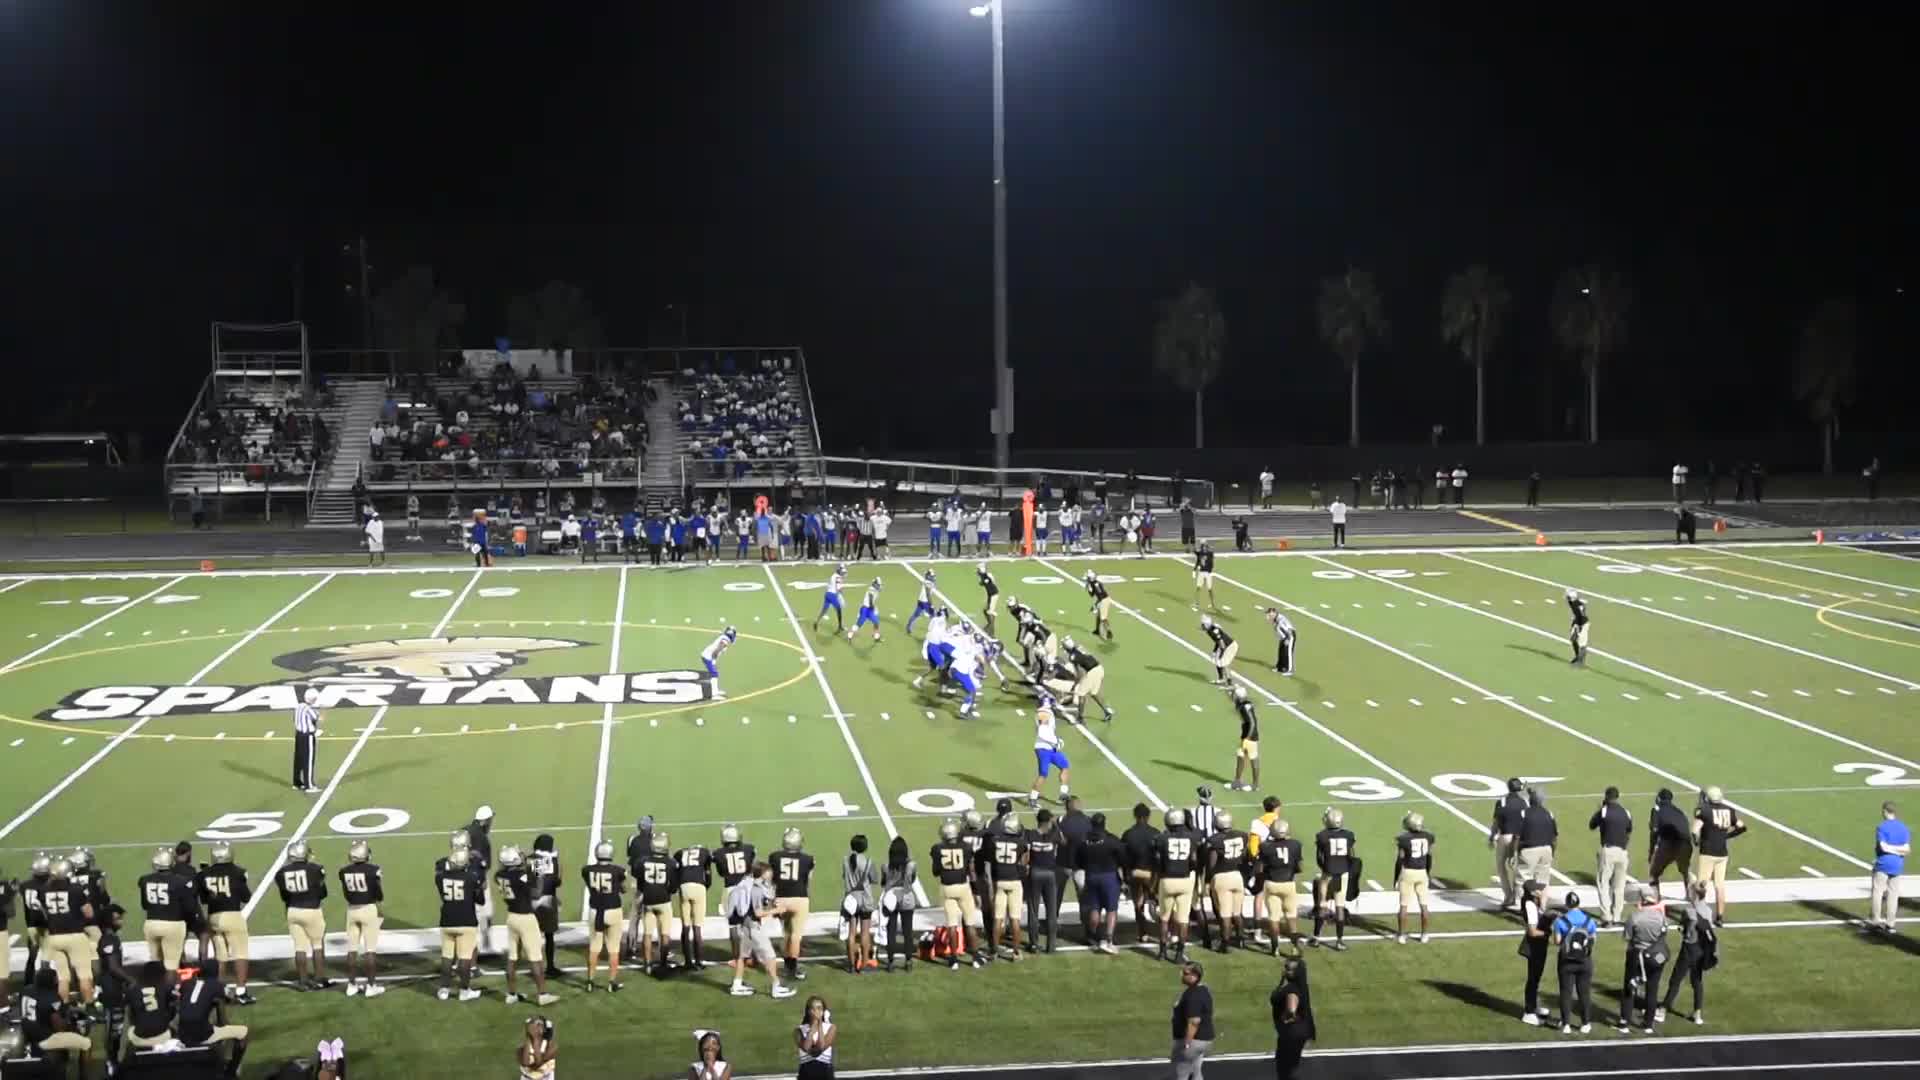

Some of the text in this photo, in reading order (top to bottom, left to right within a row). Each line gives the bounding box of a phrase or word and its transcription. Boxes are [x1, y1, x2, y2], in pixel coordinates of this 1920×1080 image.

[52, 671, 704, 720] SPARTANS
[682, 848, 700, 866] 12
[941, 849, 965, 870] 20
[996, 842, 1017, 864] 25
[1276, 847, 1289, 865] 4
[779, 857, 800, 880] 51
[589, 871, 612, 894] 45
[45, 892, 69, 914] 53
[21, 995, 37, 1020] 15
[142, 987, 158, 1011] 3
